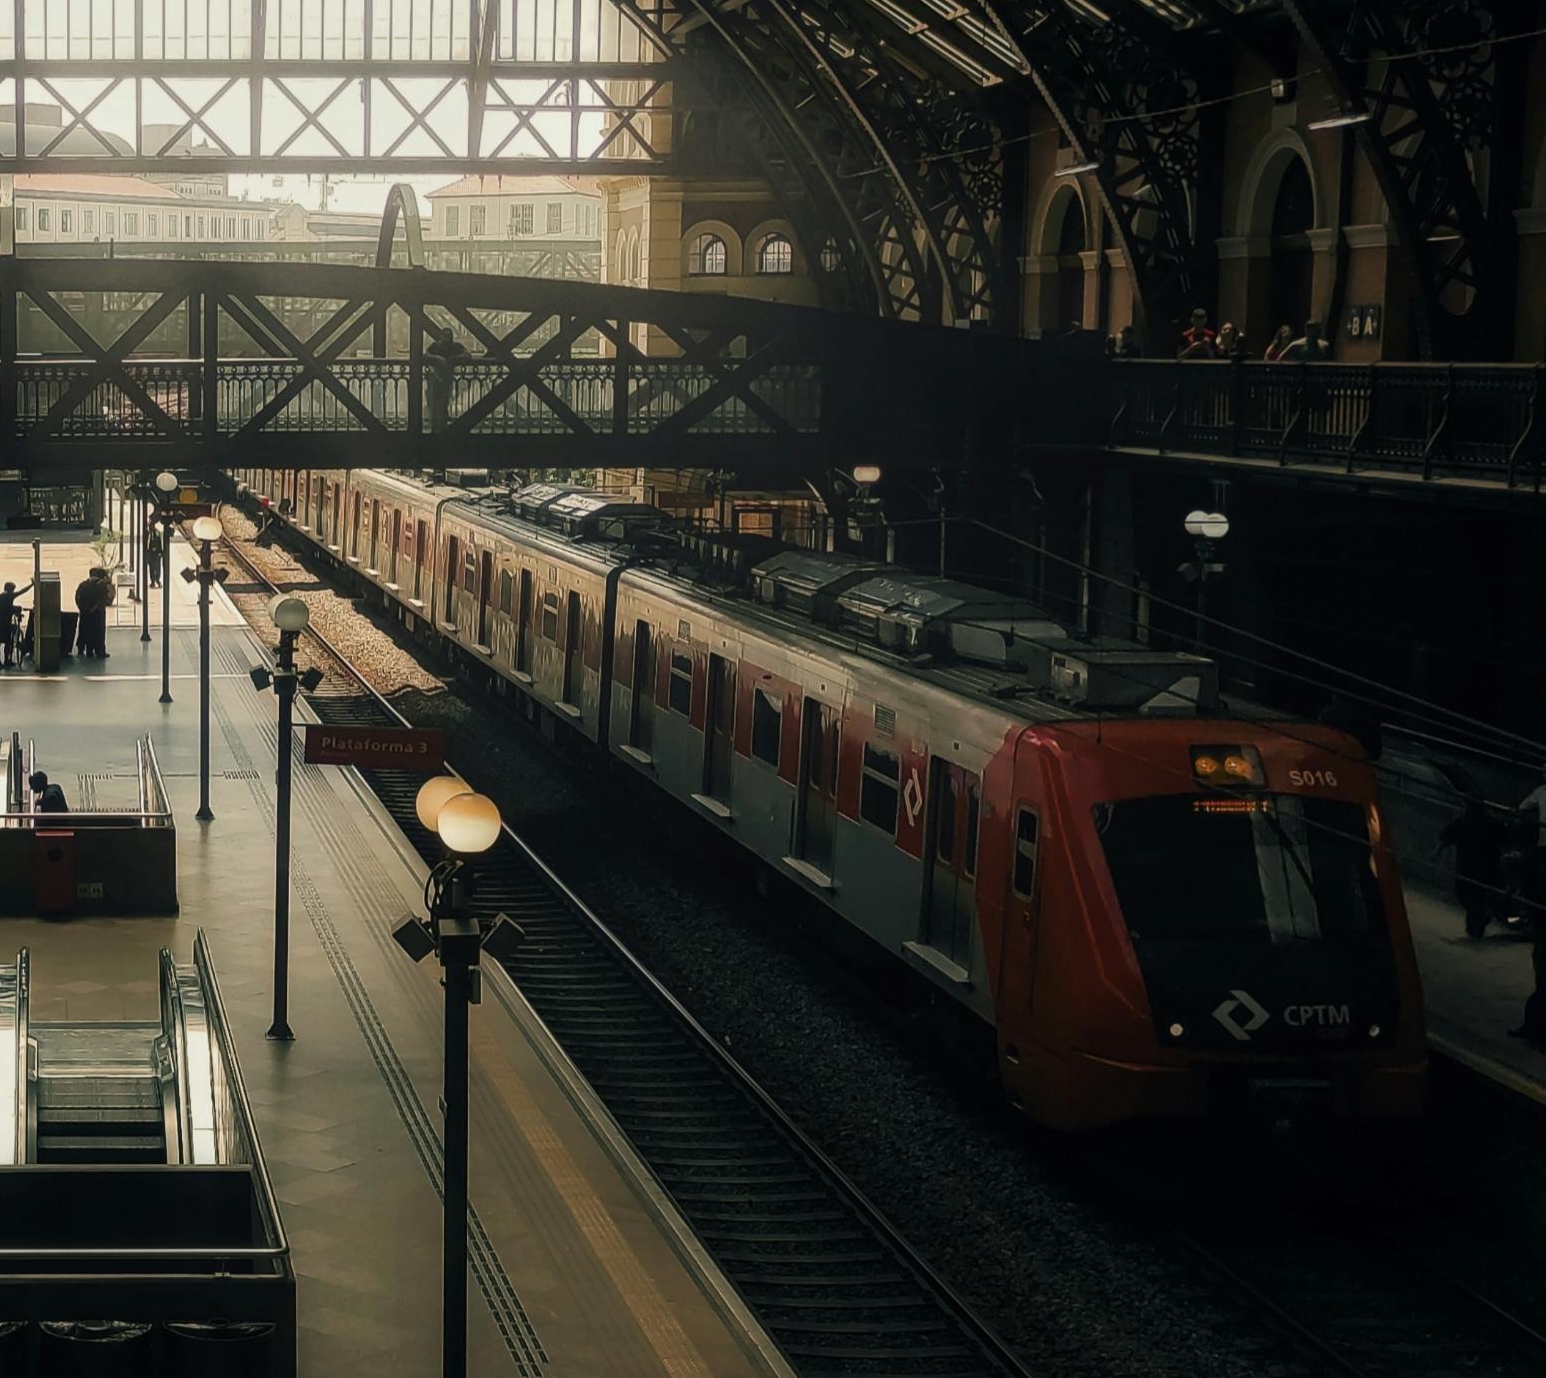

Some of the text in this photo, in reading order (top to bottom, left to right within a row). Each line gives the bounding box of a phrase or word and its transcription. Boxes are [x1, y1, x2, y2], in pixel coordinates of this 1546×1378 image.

[1351, 316, 1360, 336] B
[1363, 315, 1373, 335] A
[321, 736, 414, 754] Plataforma
[418, 741, 429, 754] 3
[1283, 1004, 1351, 1026] CPTM
